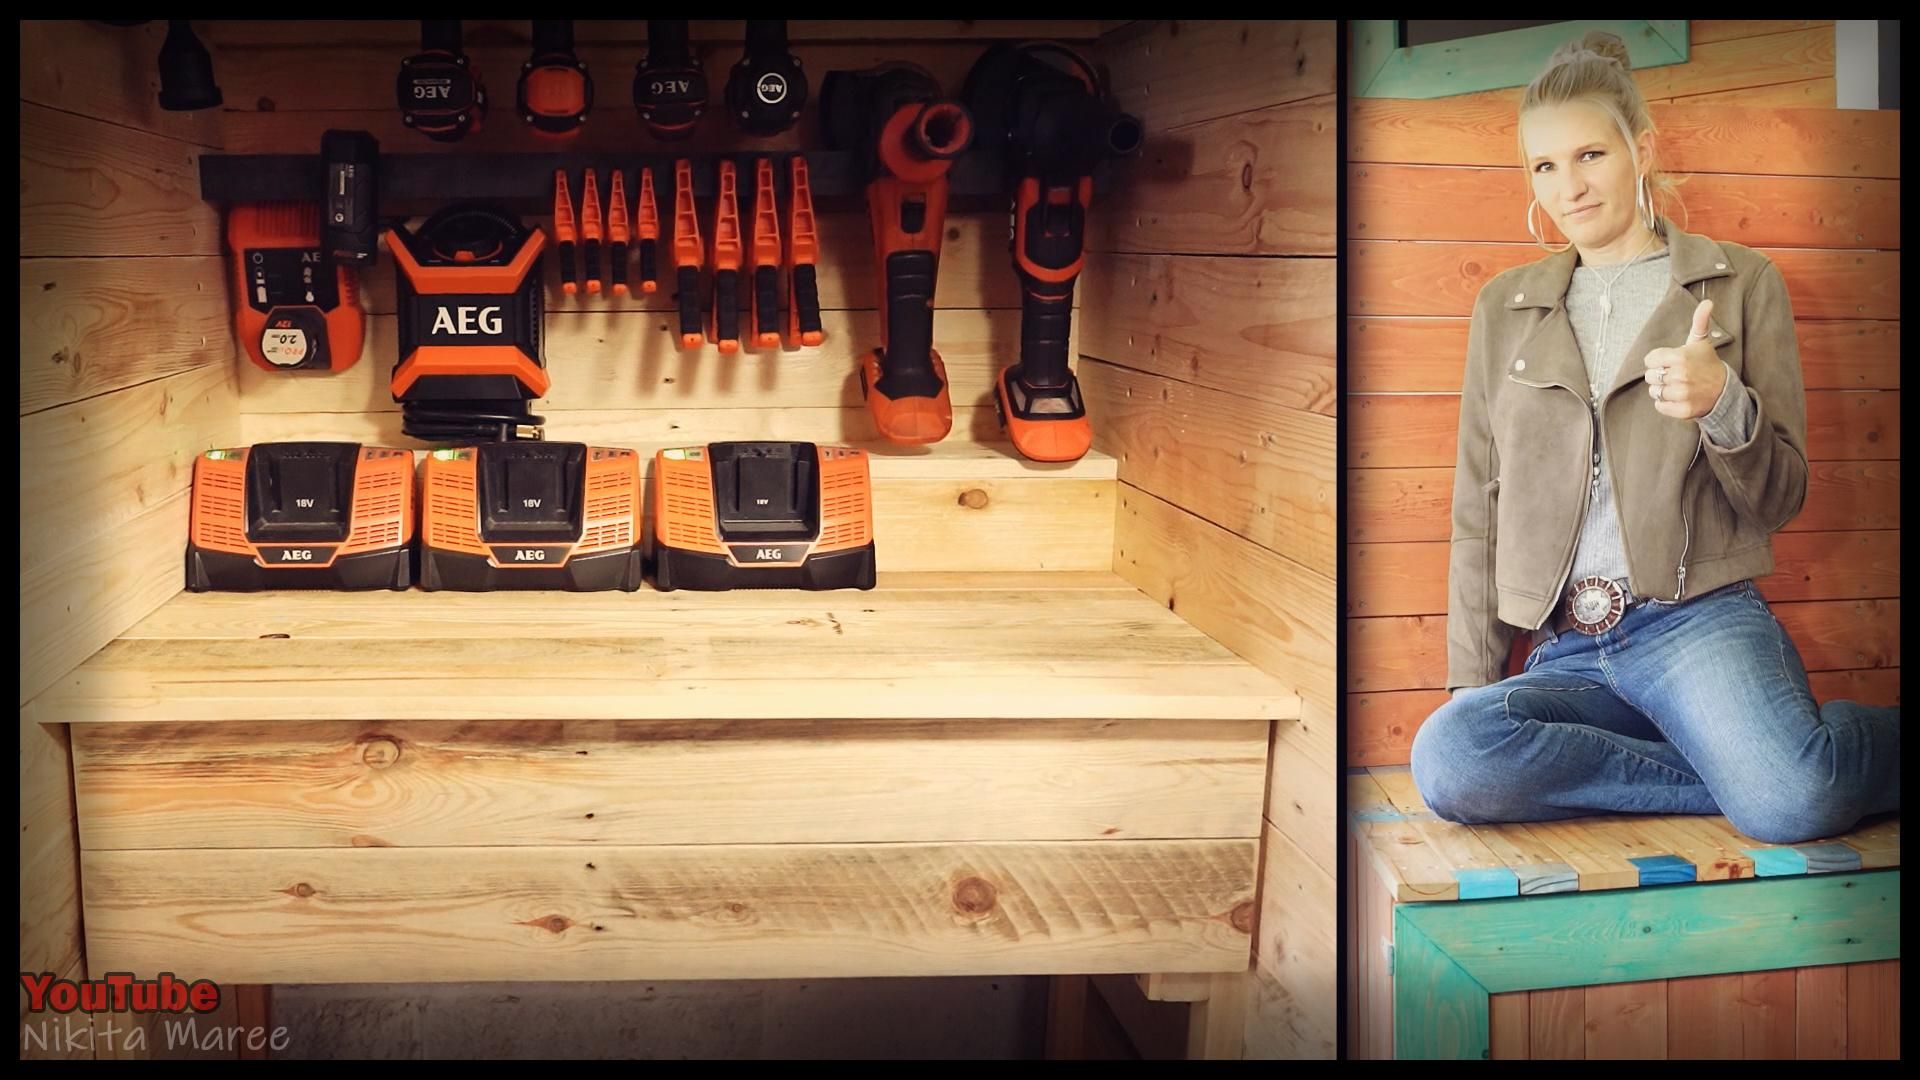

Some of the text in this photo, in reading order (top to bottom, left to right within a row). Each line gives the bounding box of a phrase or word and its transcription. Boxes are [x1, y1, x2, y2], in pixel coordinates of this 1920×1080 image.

[413, 86, 451, 99] AEG
[651, 79, 690, 95] AEG
[761, 84, 783, 93] AEG
[301, 252, 321, 263] AE
[431, 306, 503, 335] AEG
[295, 499, 314, 508] 18V
[522, 499, 541, 508] 18V
[281, 550, 312, 561] AEG
[514, 550, 545, 561] AEG
[756, 548, 782, 560] AEG
